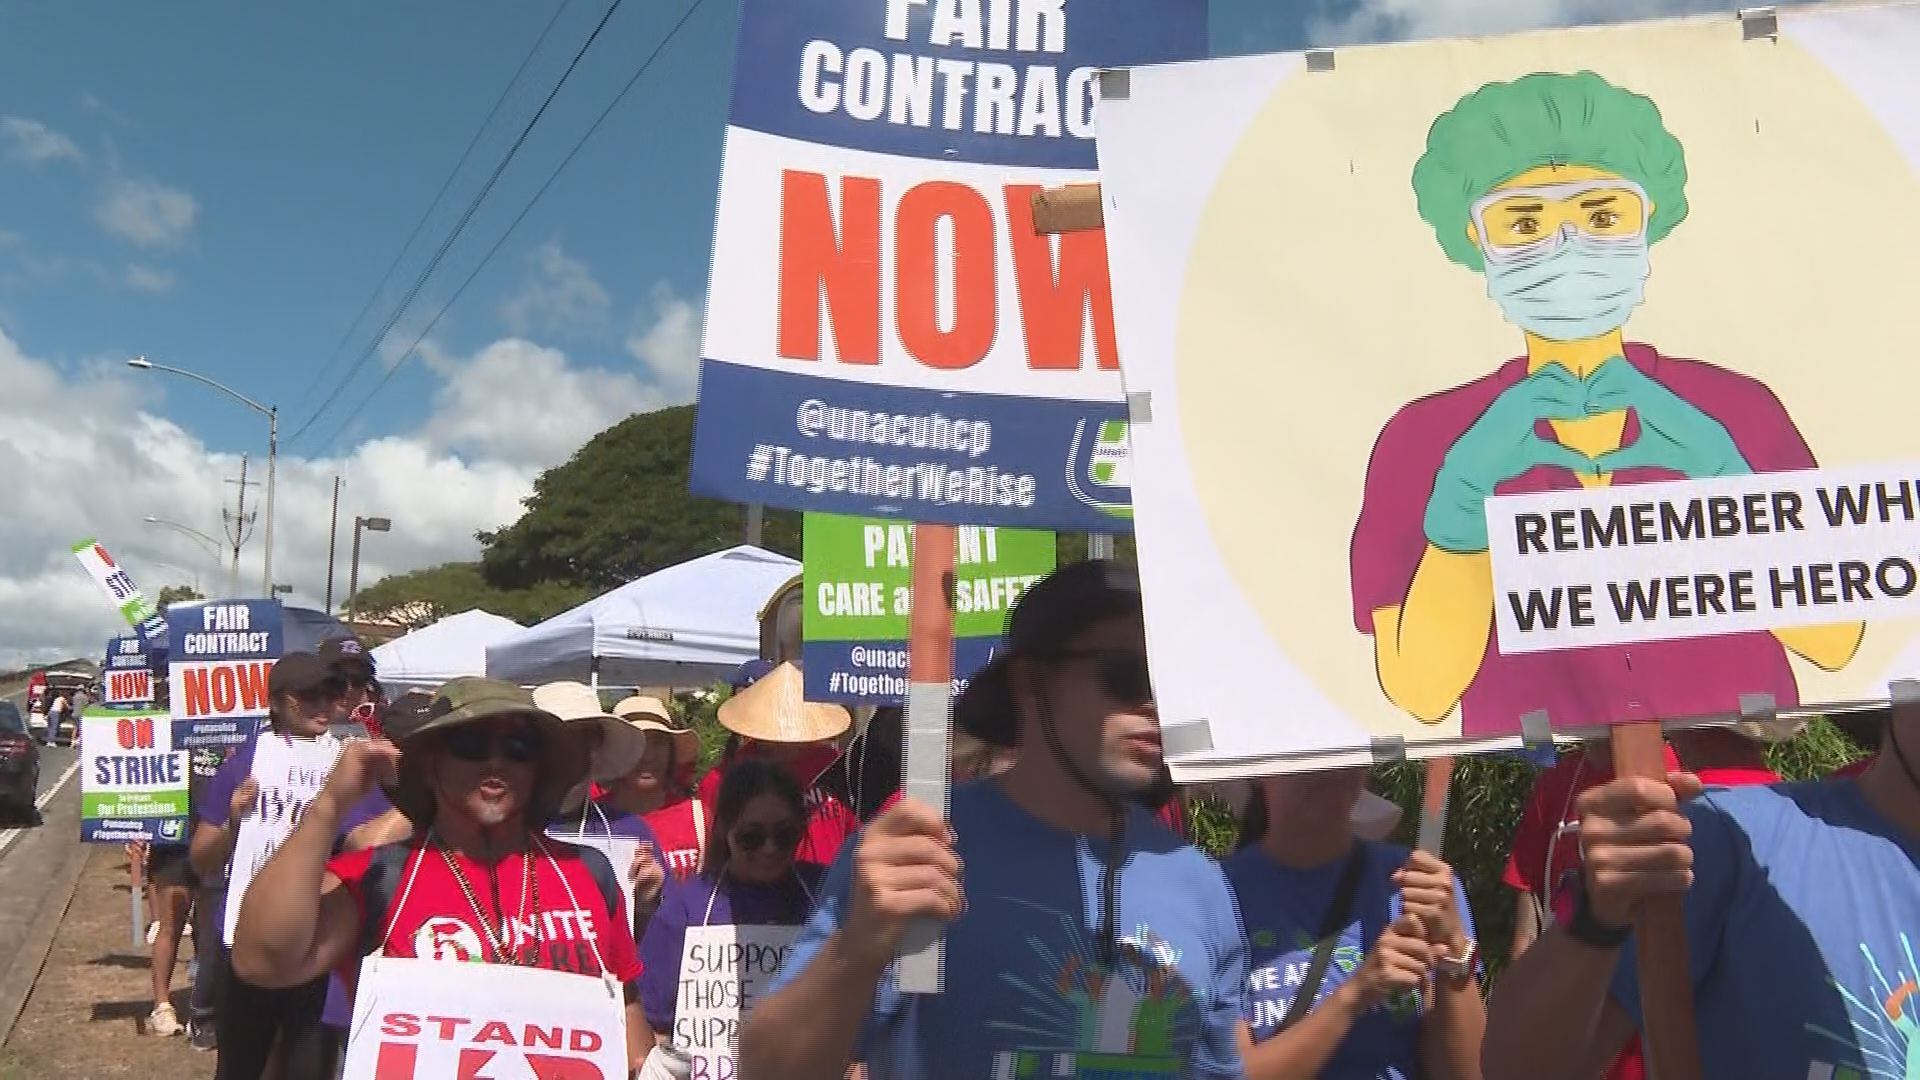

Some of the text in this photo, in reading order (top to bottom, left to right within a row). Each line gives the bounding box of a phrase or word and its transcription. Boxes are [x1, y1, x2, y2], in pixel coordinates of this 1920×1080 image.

[796, 399, 990, 458] @unacuhcp
[746, 443, 1035, 508] #TogetherWeRise
[1515, 478, 1920, 555] REMEMBER WH
[203, 604, 250, 630] FAIR
[818, 582, 886, 617] CARE
[1508, 584, 1596, 633] WE
[1607, 569, 1757, 625] WERE
[184, 632, 269, 654] CONTRACT
[111, 671, 149, 701] NOW
[183, 662, 273, 717] NOW
[117, 718, 155, 750] ON
[95, 753, 182, 785] STRIKE
[679, 979, 754, 1010] THOSE
[380, 1012, 603, 1053] STAND
